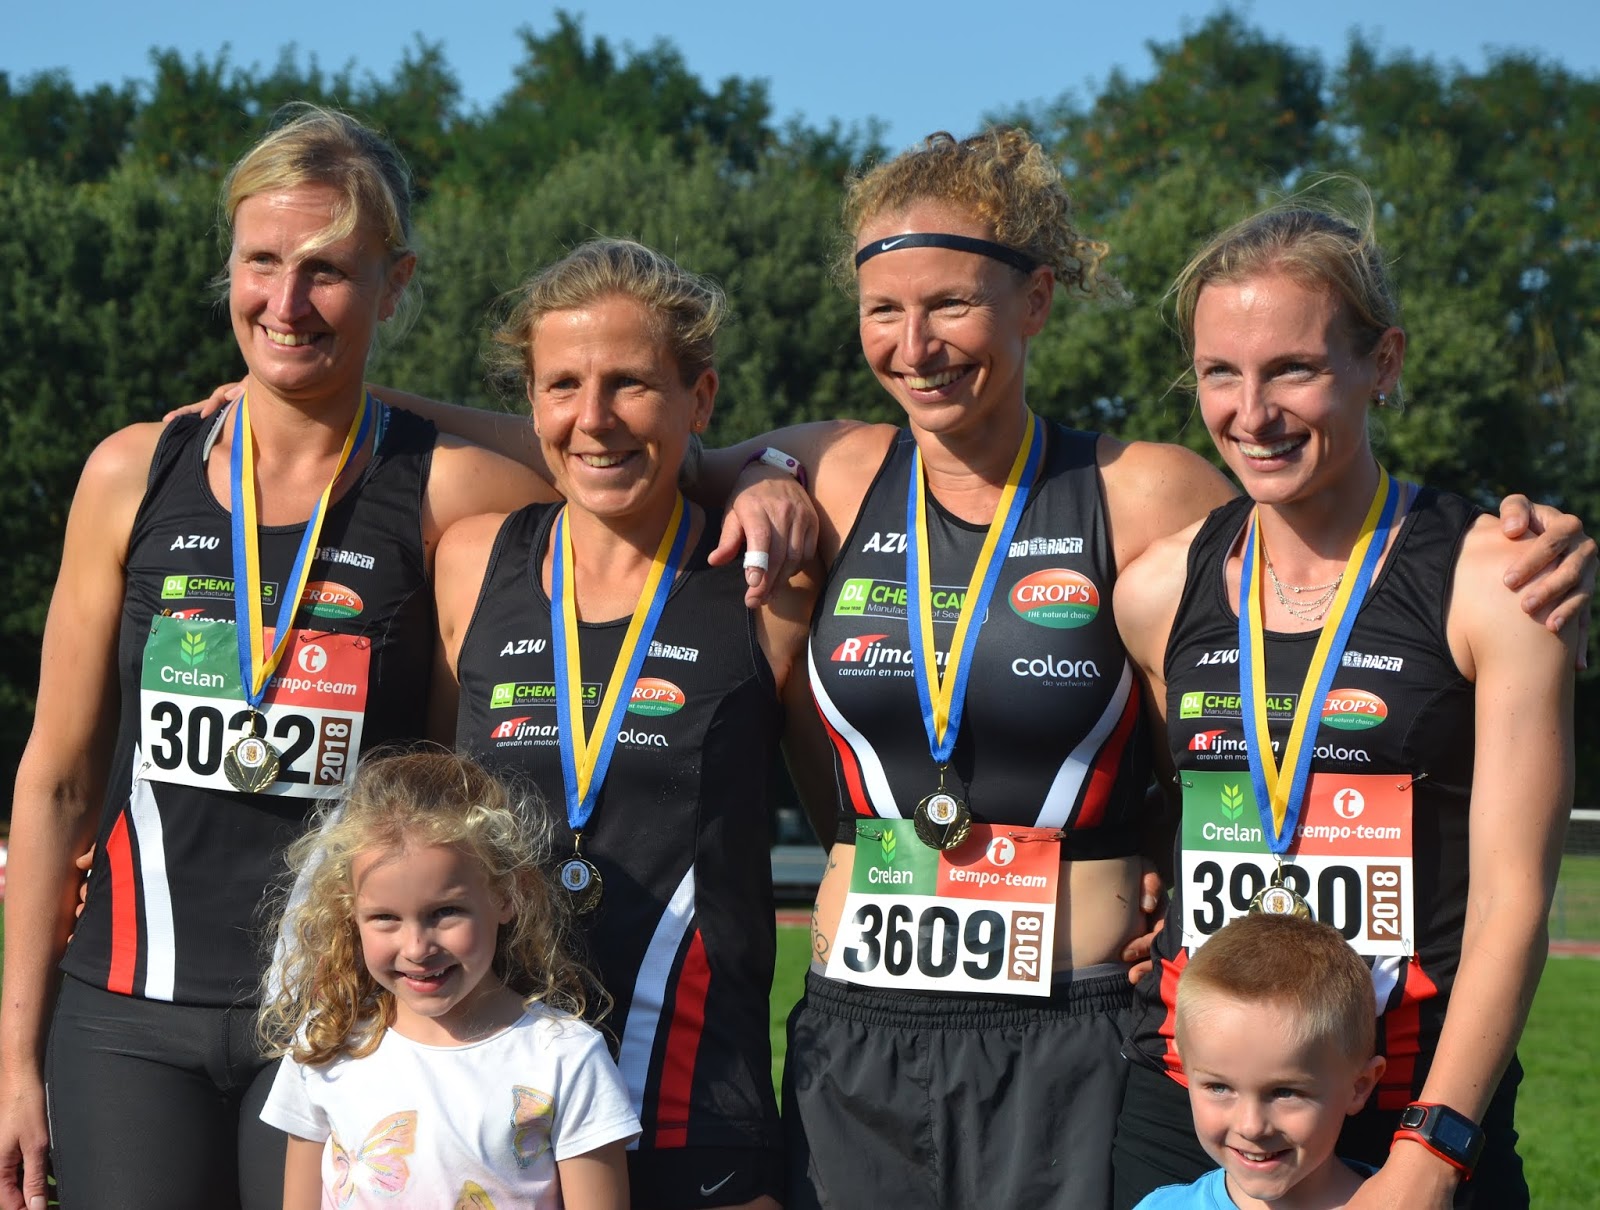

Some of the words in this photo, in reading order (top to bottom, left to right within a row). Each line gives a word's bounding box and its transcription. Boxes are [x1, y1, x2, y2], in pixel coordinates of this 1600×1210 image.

[169, 535, 220, 551] AZW
[166, 580, 183, 591] DL
[188, 579, 273, 597] CHEMIS
[843, 584, 864, 601] DL
[1016, 584, 1090, 602] CROP'S
[867, 603, 908, 615] Manufac
[1042, 610, 1069, 618] natural
[1070, 611, 1091, 619] choice
[499, 639, 546, 657] AZW
[1011, 654, 1101, 678] colora
[1195, 648, 1240, 668] AZW
[160, 665, 224, 688] Crelan
[838, 667, 876, 677] caravan
[878, 669, 891, 677] en
[269, 677, 357, 696] empo-team
[495, 688, 511, 699] DL
[516, 685, 597, 699] CHEMLS
[632, 687, 679, 702] ROP'S
[1183, 696, 1200, 709] DL
[1204, 708, 1242, 716] Manufactu
[496, 740, 522, 748] caravan
[617, 728, 669, 747] olora
[320, 722, 349, 781] 2018
[1196, 753, 1223, 761] caravan
[1313, 743, 1371, 762] olora
[1202, 822, 1262, 842] Crelan
[1297, 823, 1401, 843] tempo-team
[868, 866, 913, 884] Crelan
[949, 867, 1047, 888] tempo-team
[1372, 870, 1399, 935] 2018
[843, 903, 1006, 981] 3609
[1013, 916, 1041, 977] 2018
